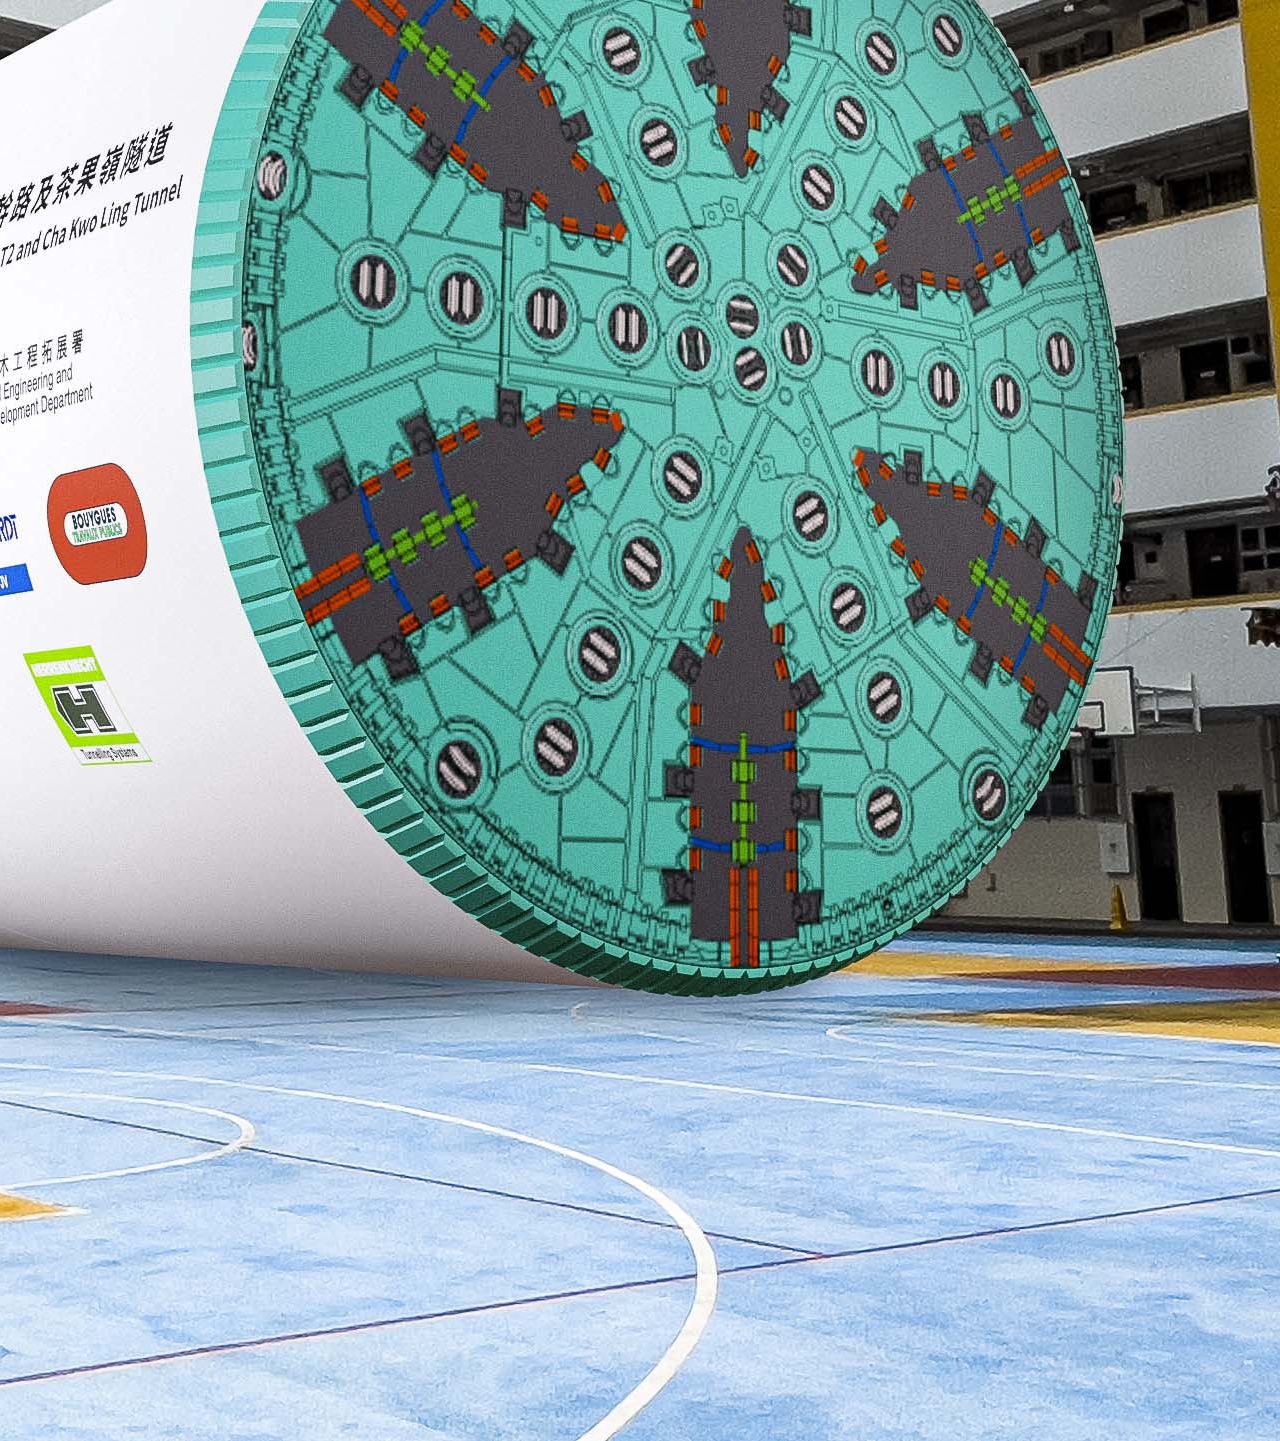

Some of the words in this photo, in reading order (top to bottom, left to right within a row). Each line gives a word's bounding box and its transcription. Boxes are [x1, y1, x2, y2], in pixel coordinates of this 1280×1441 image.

[0, 242, 16, 267] T2
[16, 231, 42, 258] and
[42, 222, 67, 250] Cha
[69, 215, 98, 241] Kwo
[100, 201, 130, 228] Ling
[134, 174, 184, 216] Tunnel
[3, 373, 54, 401] Engineering
[56, 361, 73, 382] and
[41, 382, 94, 416] Department
[72, 506, 117, 530] BOUYGUES
[0, 574, 9, 590] JV
